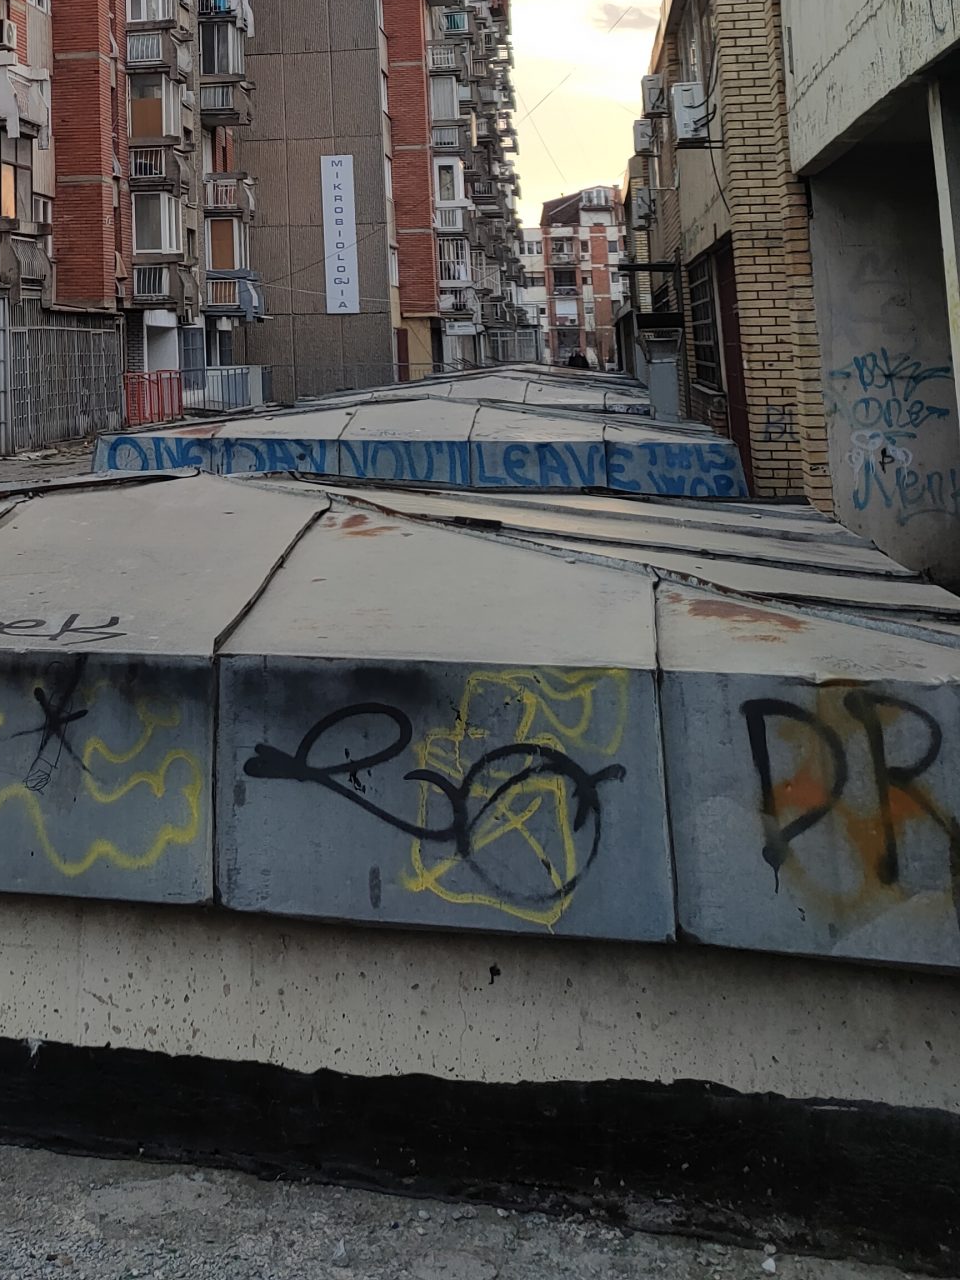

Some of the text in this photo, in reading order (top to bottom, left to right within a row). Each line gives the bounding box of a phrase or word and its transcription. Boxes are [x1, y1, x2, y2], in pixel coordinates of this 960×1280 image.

[330, 159, 351, 309] MIKROBIOLOGJIA
[476, 441, 640, 490] LEAVE
[639, 443, 737, 473] THIS
